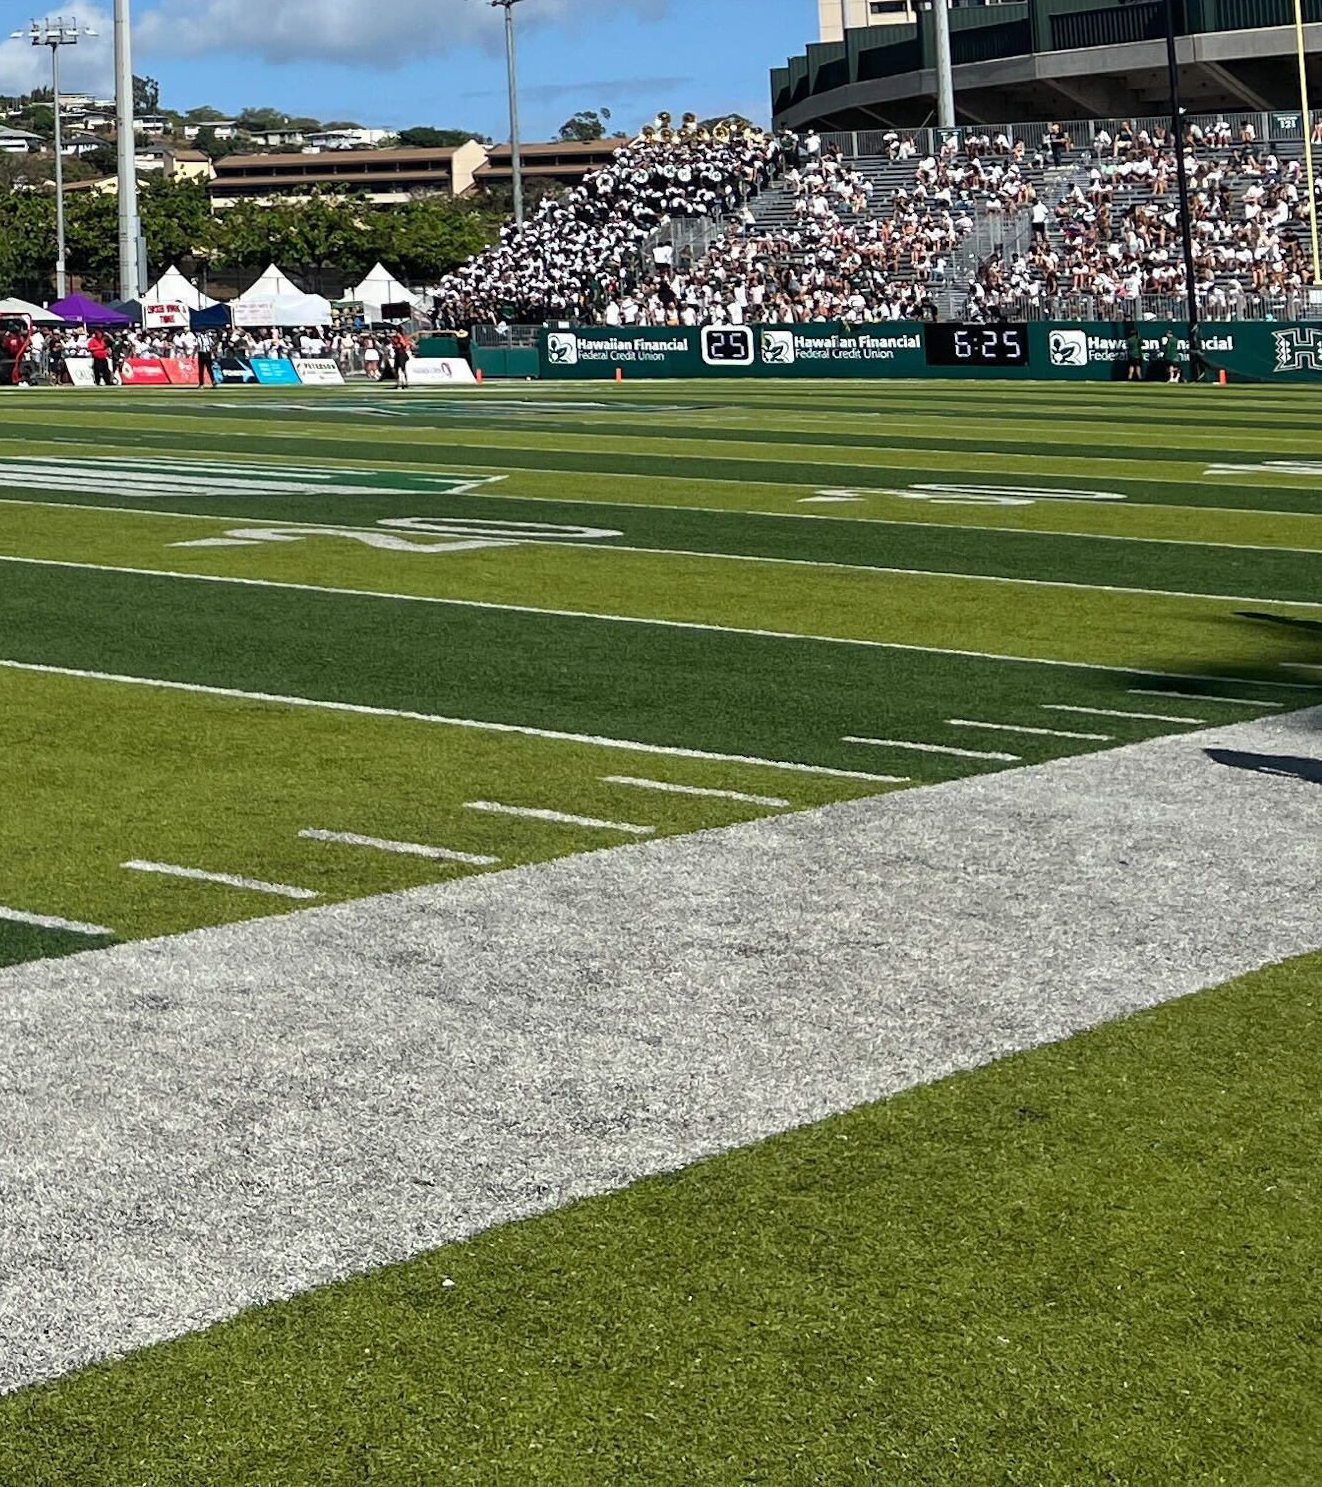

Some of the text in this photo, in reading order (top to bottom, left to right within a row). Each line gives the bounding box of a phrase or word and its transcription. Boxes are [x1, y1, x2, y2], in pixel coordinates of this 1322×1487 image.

[577, 337, 688, 351] Hawaiian Financial
[710, 332, 745, 358] 25
[794, 333, 921, 349] Hawaiian Financial
[954, 330, 1021, 358] 6:25
[1088, 336, 1159, 350] Hawaan
[577, 351, 665, 361] Federal Credit Union
[795, 348, 895, 359] Federal Credit Union
